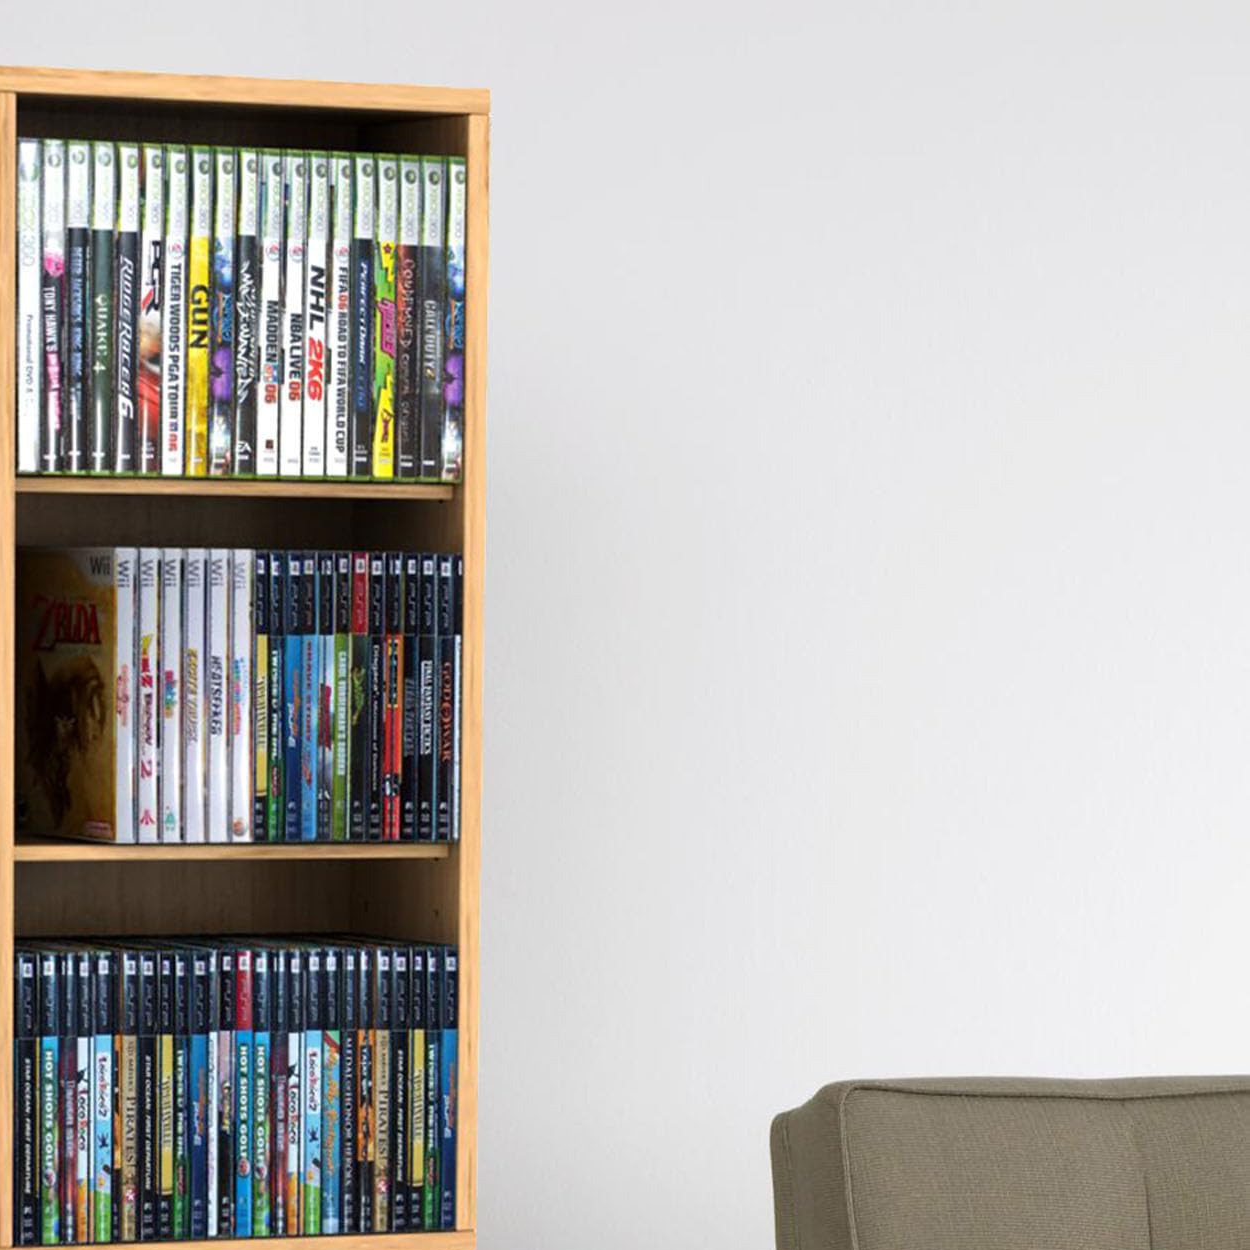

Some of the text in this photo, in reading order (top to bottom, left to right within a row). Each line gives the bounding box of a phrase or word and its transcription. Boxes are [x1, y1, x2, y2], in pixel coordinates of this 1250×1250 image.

[25, 315, 33, 384] Promotional DVD
[44, 287, 57, 352] TONY HAWK'S
[119, 255, 133, 418] RIDGE RACER 6
[169, 264, 181, 381] TIGER WOODS PGA
[190, 285, 207, 348] GUN
[307, 265, 325, 401] NHL 2K6
[424, 301, 436, 331] CALL
[94, 361, 106, 373] 4
[266, 301, 277, 404] MADDEN 06
[289, 314, 302, 400] NBA LIVE 06
[335, 267, 348, 453] FIFA ROAD TO FIFA WORLD CUP
[118, 560, 130, 587] Wii
[165, 560, 176, 586] Wii
[187, 560, 199, 587] Wii
[234, 562, 246, 589] Wii
[31, 594, 102, 652] ZELDA
[442, 662, 451, 761] GOD WAR
[45, 1051, 53, 1167] HOT SHOTS GOLF
[239, 1046, 248, 1159] HOT SHOTS GOLF
[256, 1046, 265, 1161] HOT SHOTS GOLF
[344, 1038, 353, 1139] MEDAL HONOR
[378, 1090, 389, 1158] PIRATES!
[125, 1096, 136, 1167] PIRATES!
